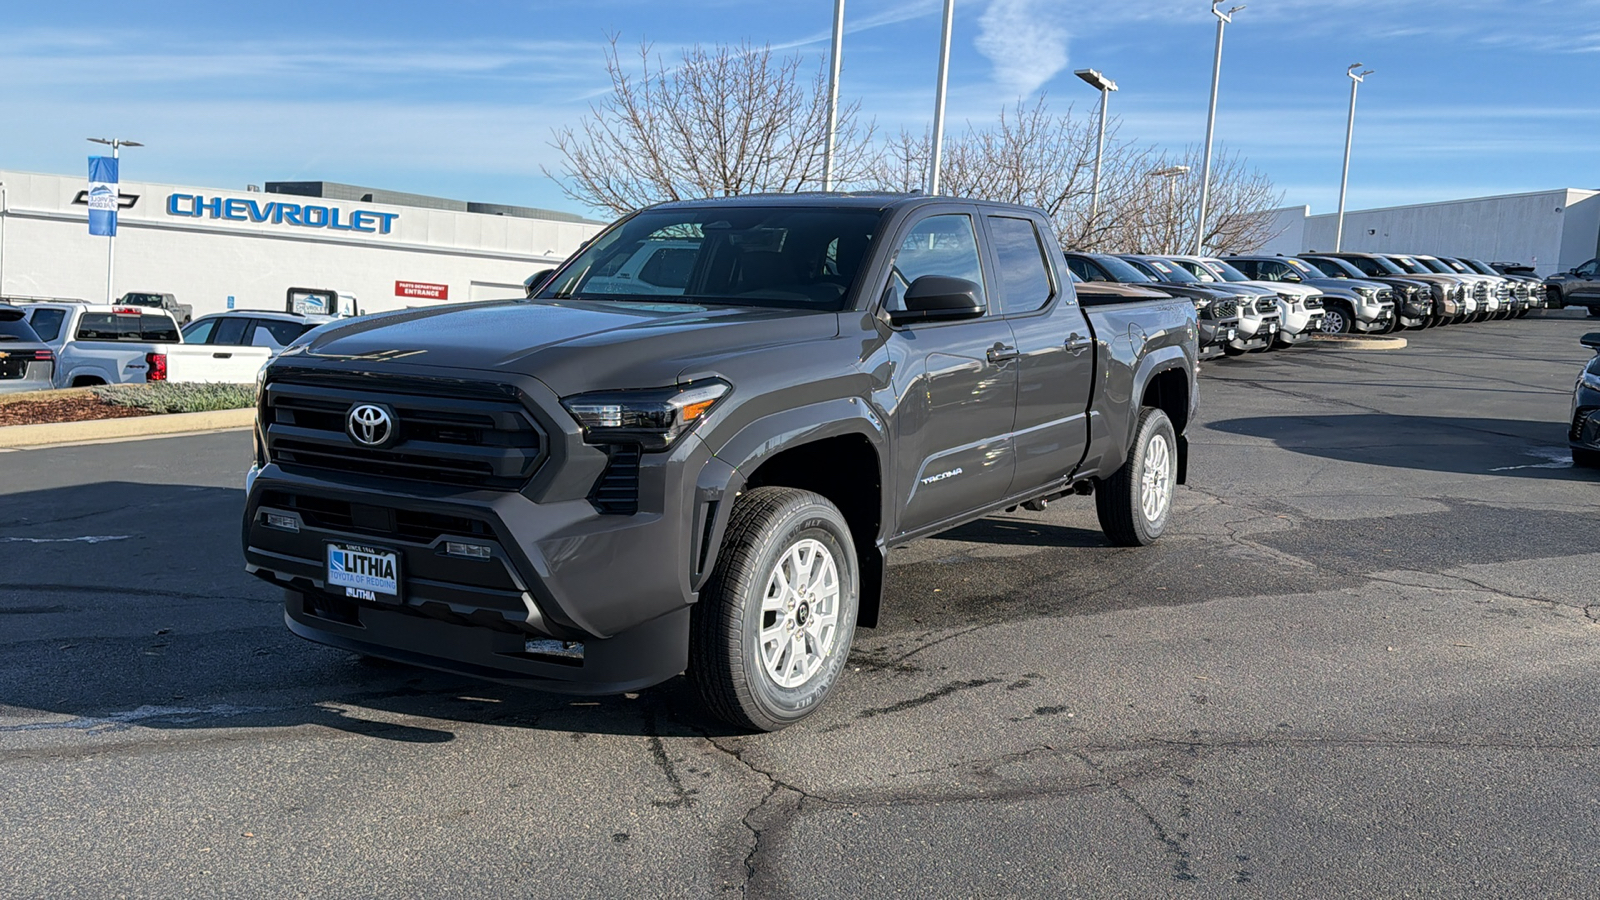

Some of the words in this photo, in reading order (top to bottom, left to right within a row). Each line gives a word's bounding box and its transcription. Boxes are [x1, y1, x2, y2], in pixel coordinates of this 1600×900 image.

[167, 193, 399, 234] CHEVROLET
[404, 288, 440, 298] ENTRANCE
[415, 283, 445, 292] DEPARTMENT
[920, 467, 963, 484] TACOMA
[344, 552, 395, 580] LITHIA
[330, 570, 355, 581] TOYOTA
[356, 574, 365, 583] OF
[366, 576, 396, 589] REDDING
[352, 588, 376, 601] LITHIA
